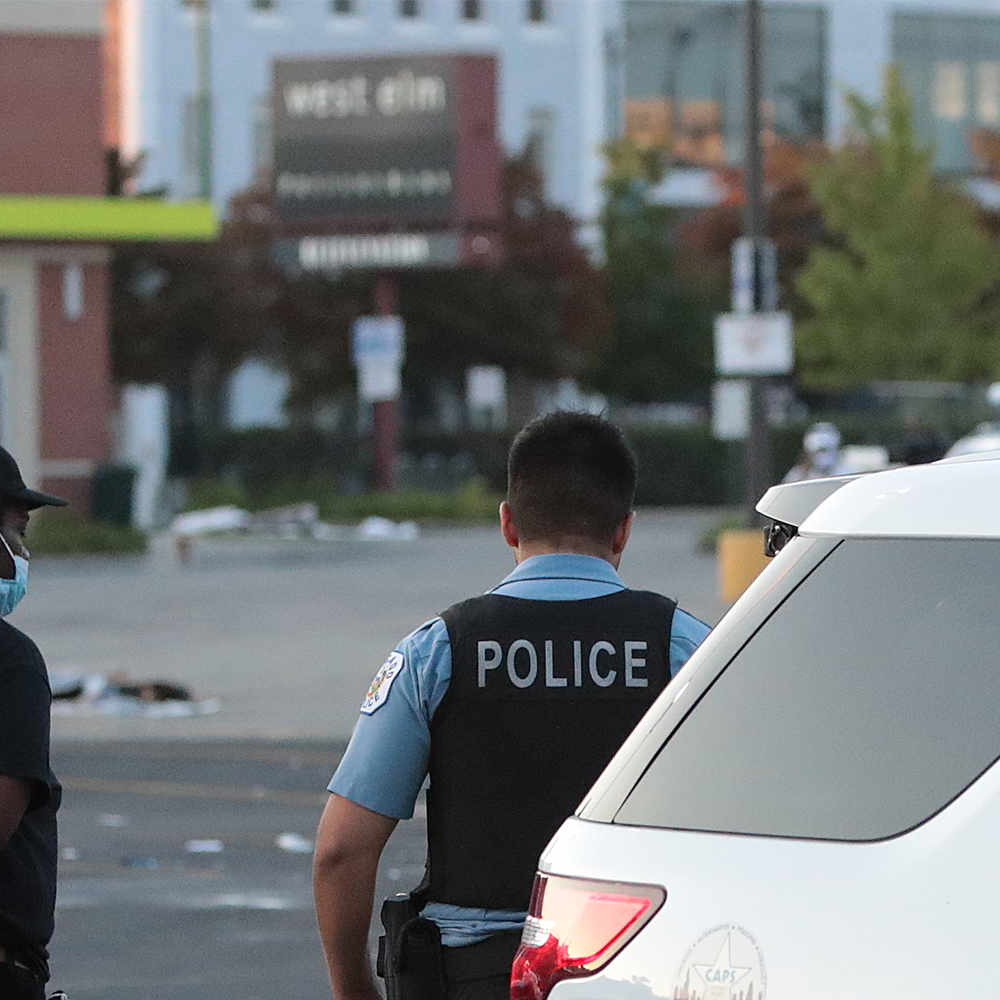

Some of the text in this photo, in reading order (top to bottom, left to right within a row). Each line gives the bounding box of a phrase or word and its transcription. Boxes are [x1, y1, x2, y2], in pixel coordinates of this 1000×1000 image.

[284, 69, 446, 118] west elm
[477, 639, 649, 689] POLICE
[705, 968, 737, 983] CAPS
